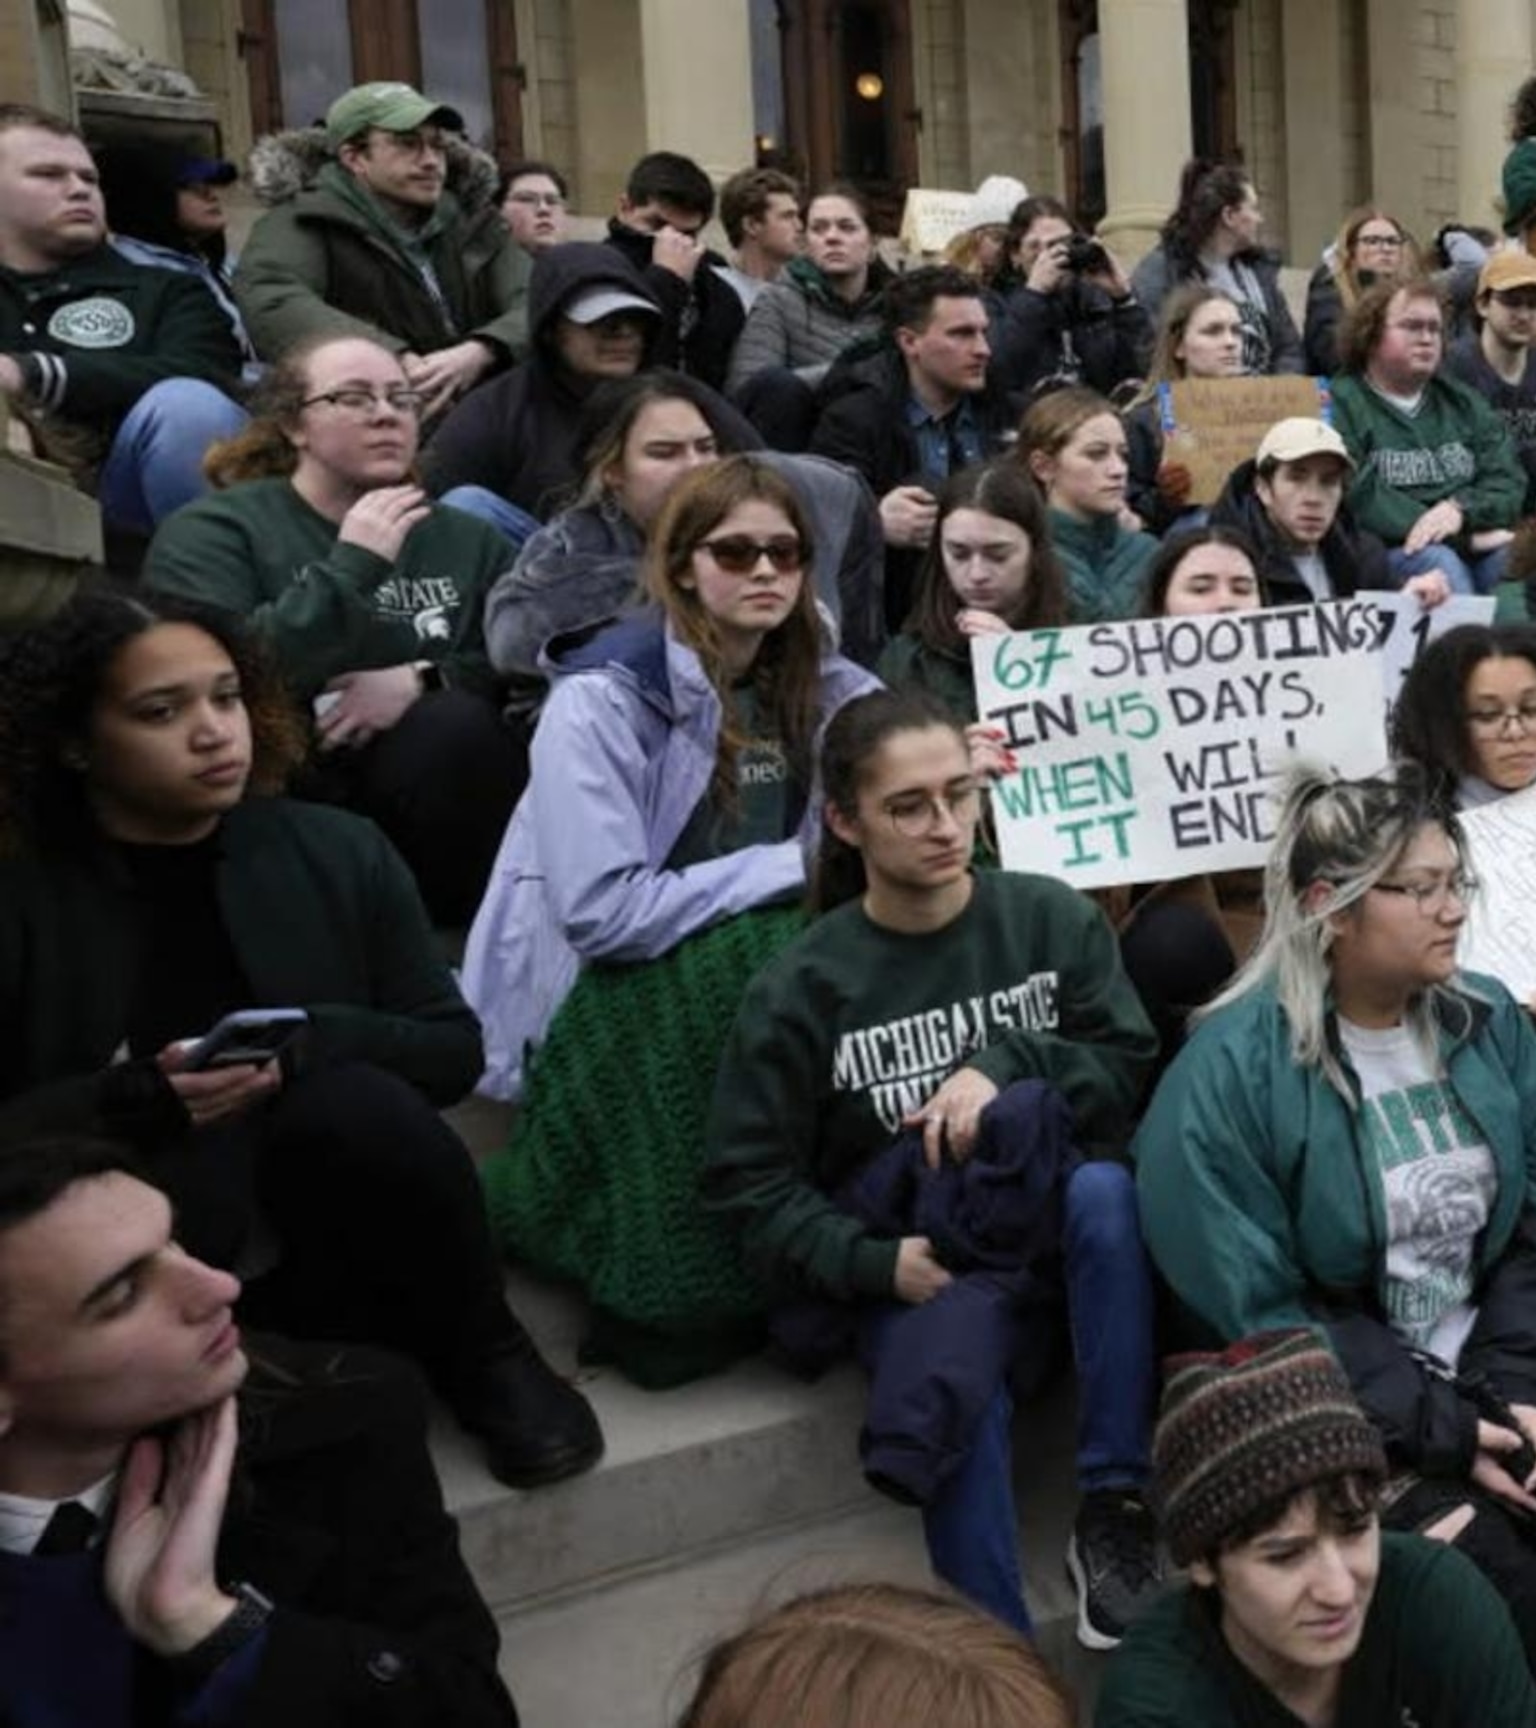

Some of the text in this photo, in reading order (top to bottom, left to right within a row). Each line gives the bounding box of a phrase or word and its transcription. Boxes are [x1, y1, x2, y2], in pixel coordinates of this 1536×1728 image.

[993, 628, 1073, 690] 67
[987, 671, 1324, 749] IN 45 DAYS,
[995, 751, 1135, 819] WHEN
[1055, 808, 1138, 868] IT
